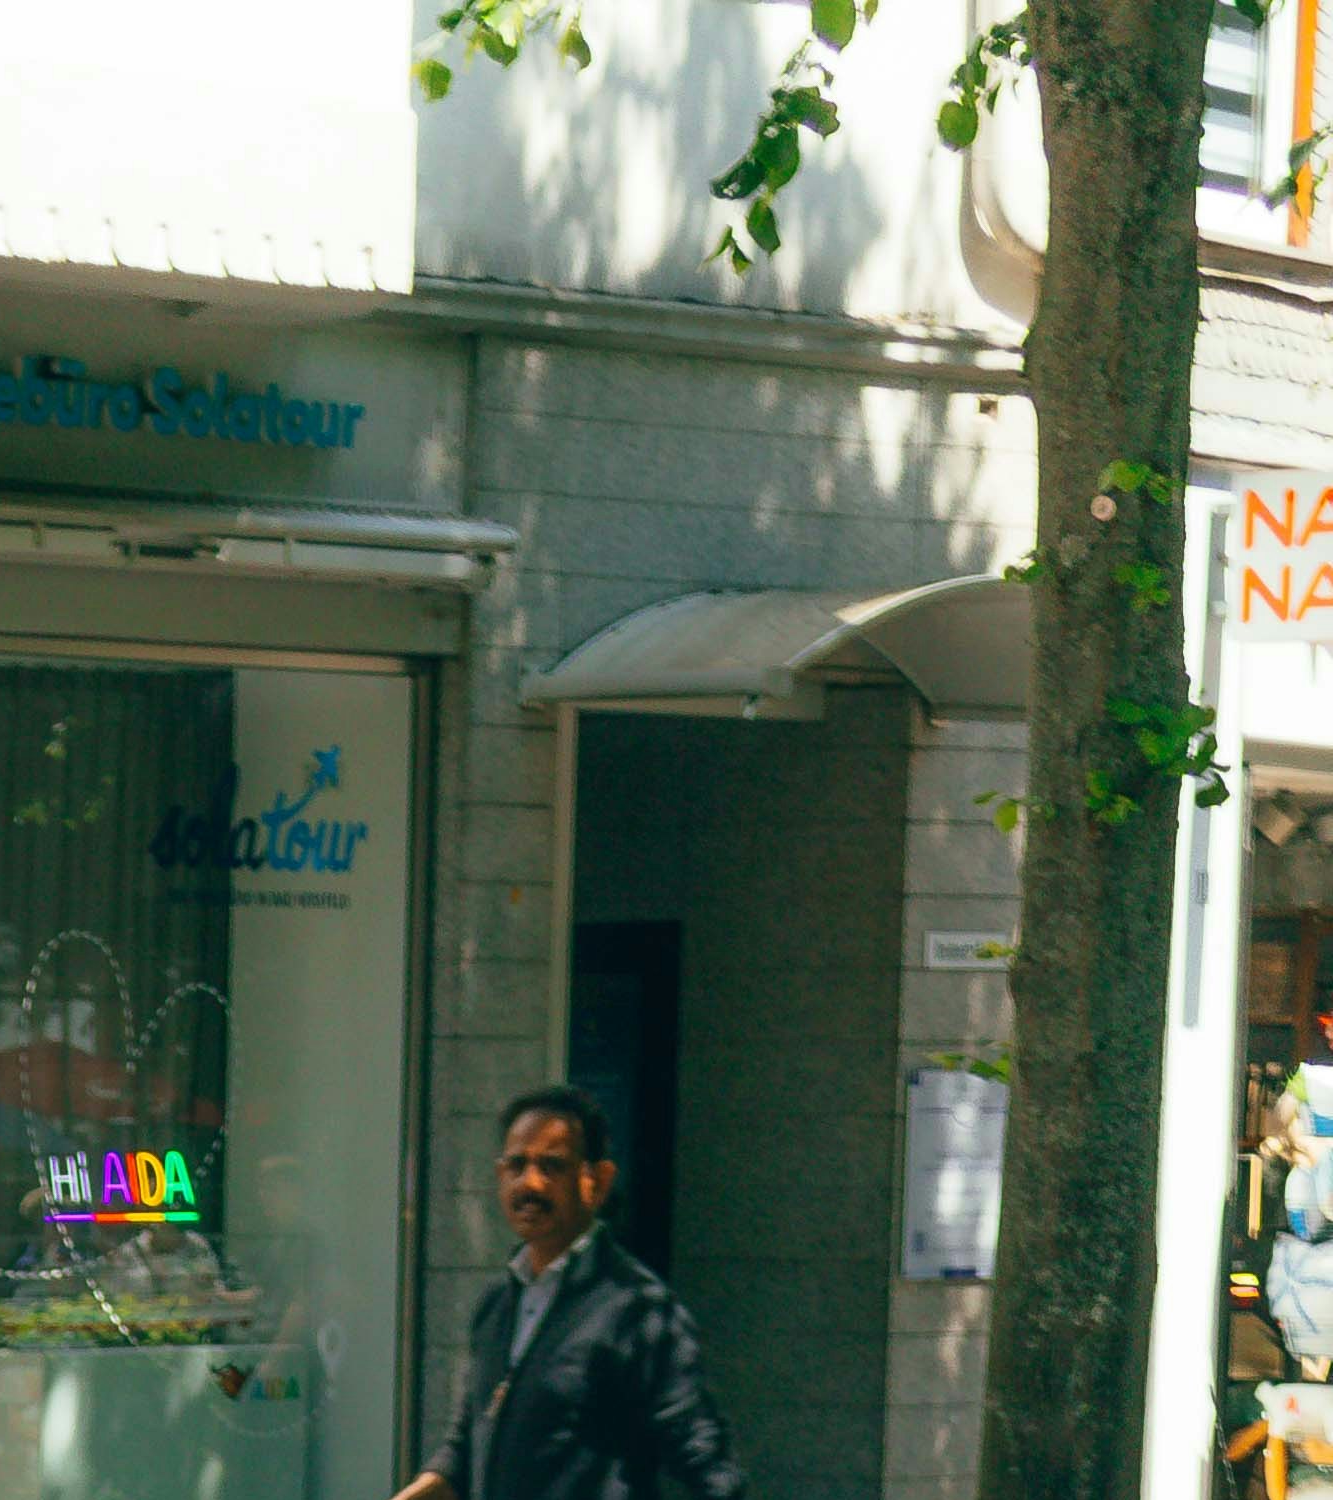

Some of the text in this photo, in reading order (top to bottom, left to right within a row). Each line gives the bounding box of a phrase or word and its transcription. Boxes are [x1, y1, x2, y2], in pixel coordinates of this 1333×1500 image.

[145, 364, 366, 450] Solatour
[49, 1149, 196, 1207] Hi AIDA
